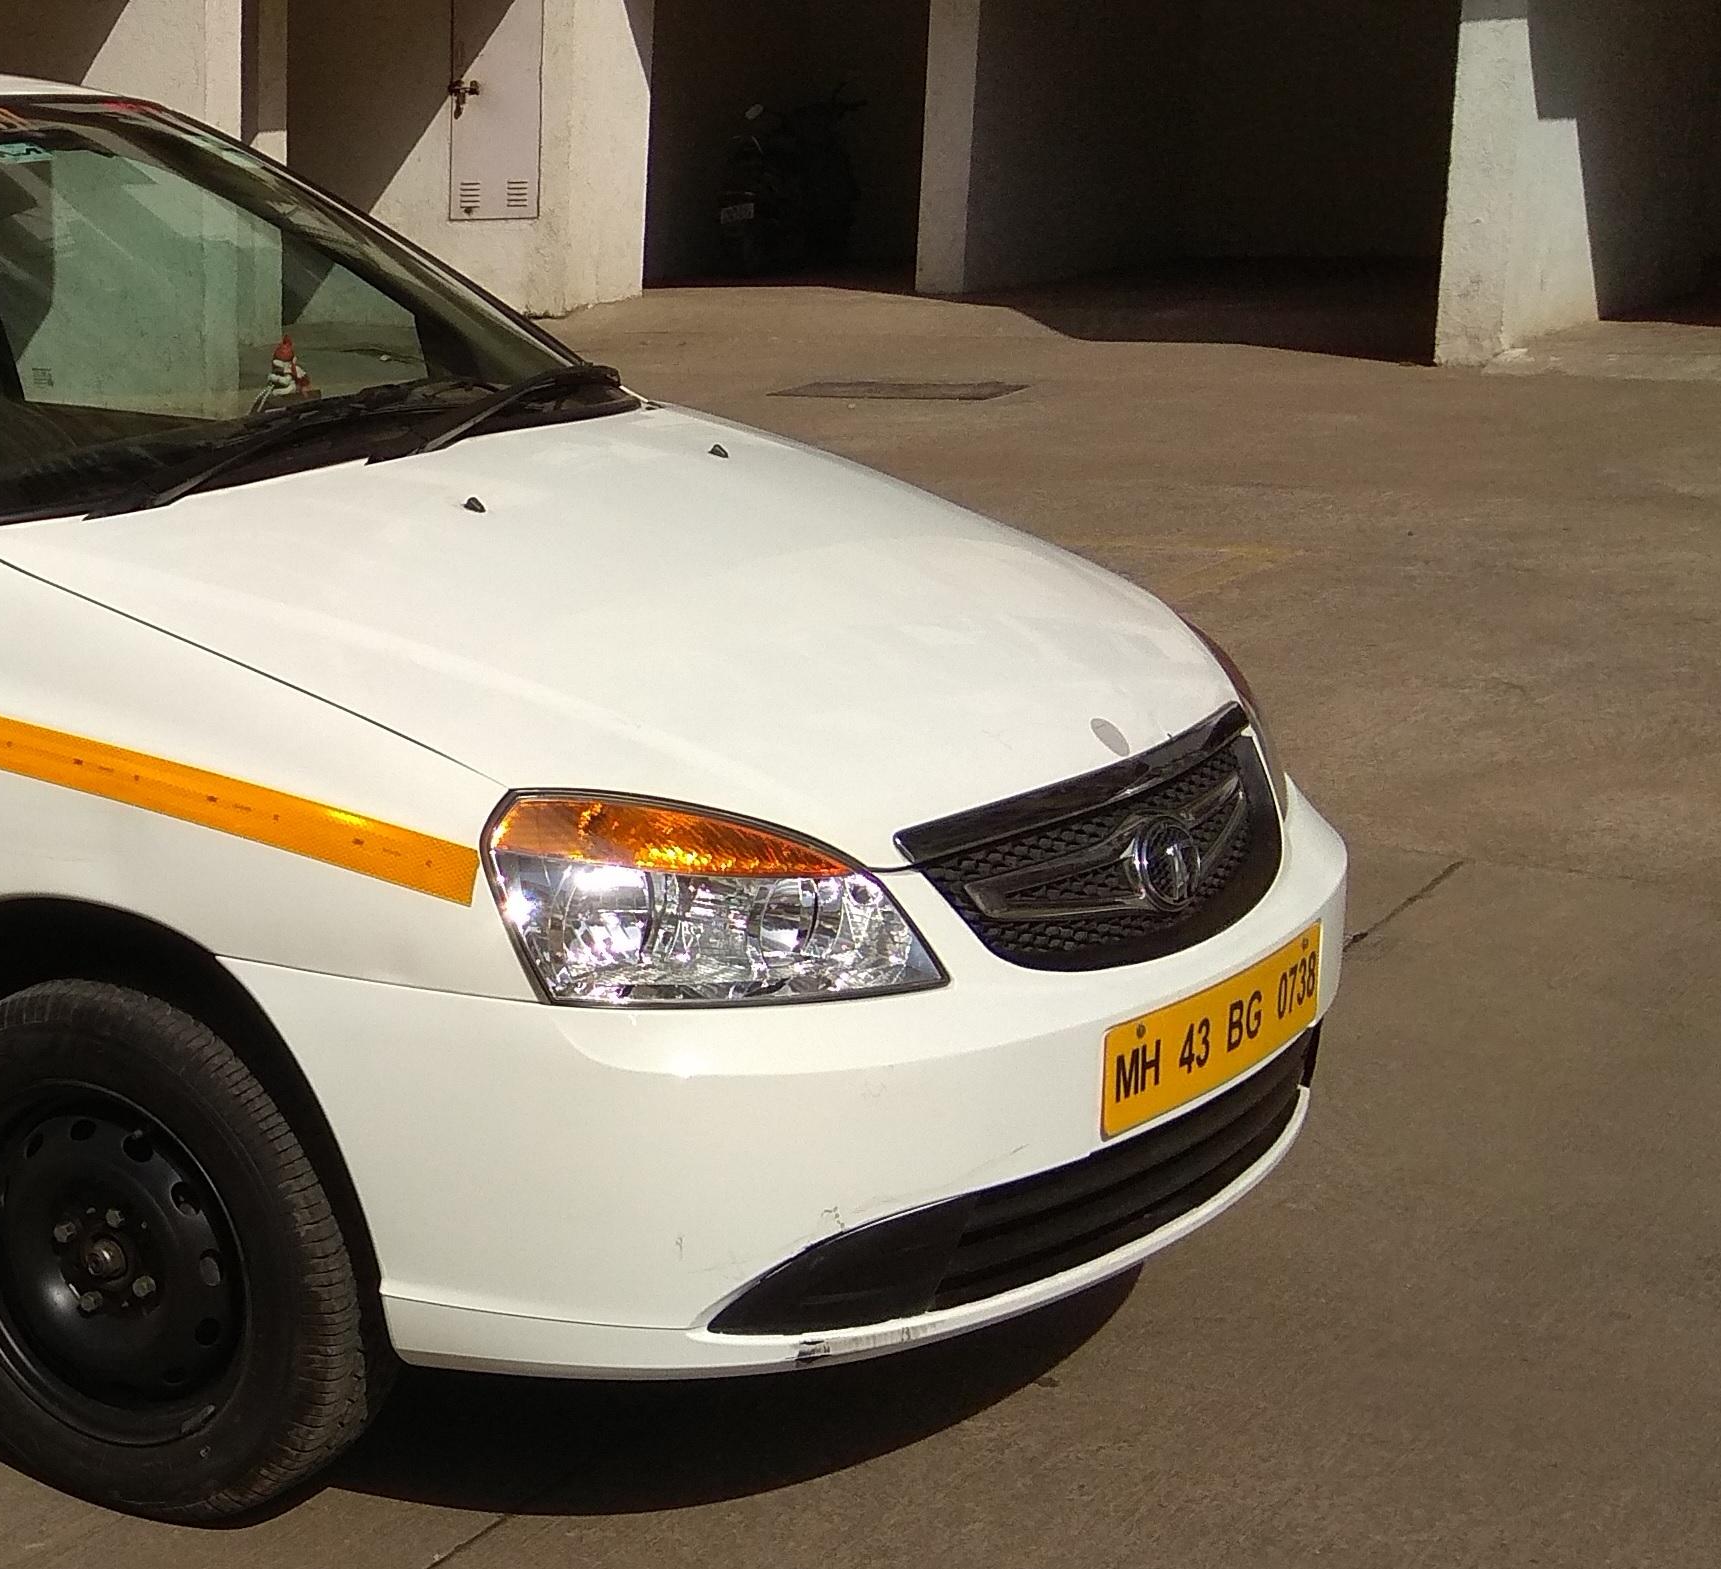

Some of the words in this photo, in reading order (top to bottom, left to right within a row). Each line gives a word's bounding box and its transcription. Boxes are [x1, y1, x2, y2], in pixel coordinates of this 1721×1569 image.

[1115, 1039, 1161, 1103] MH
[1179, 1018, 1210, 1074] 43
[1227, 990, 1262, 1053] BG
[1278, 951, 1316, 1020] 0738
